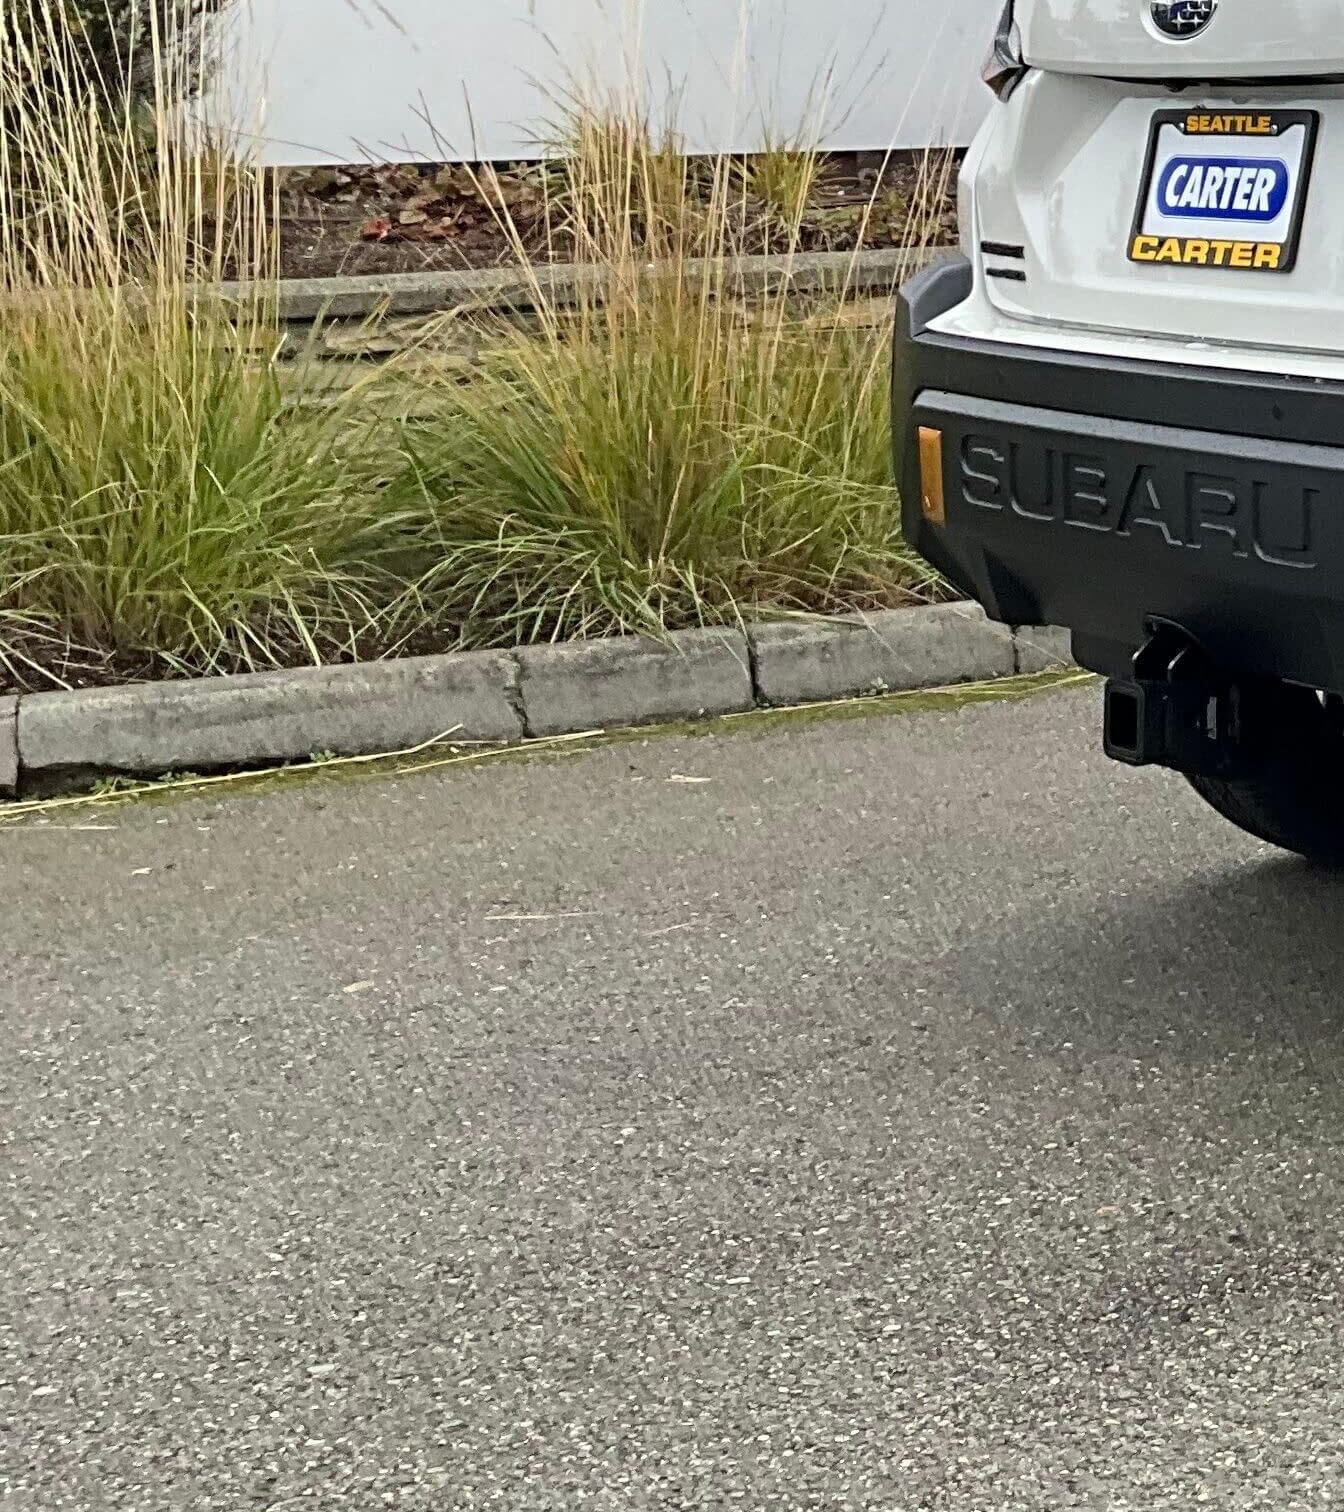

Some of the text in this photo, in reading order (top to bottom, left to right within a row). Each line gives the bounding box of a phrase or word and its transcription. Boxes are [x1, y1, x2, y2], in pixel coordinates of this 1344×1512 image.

[1186, 115, 1271, 133] SEATTLE
[1164, 164, 1277, 212] CARTER
[1131, 235, 1281, 268] CARTER
[960, 434, 1320, 569] SUBARU
